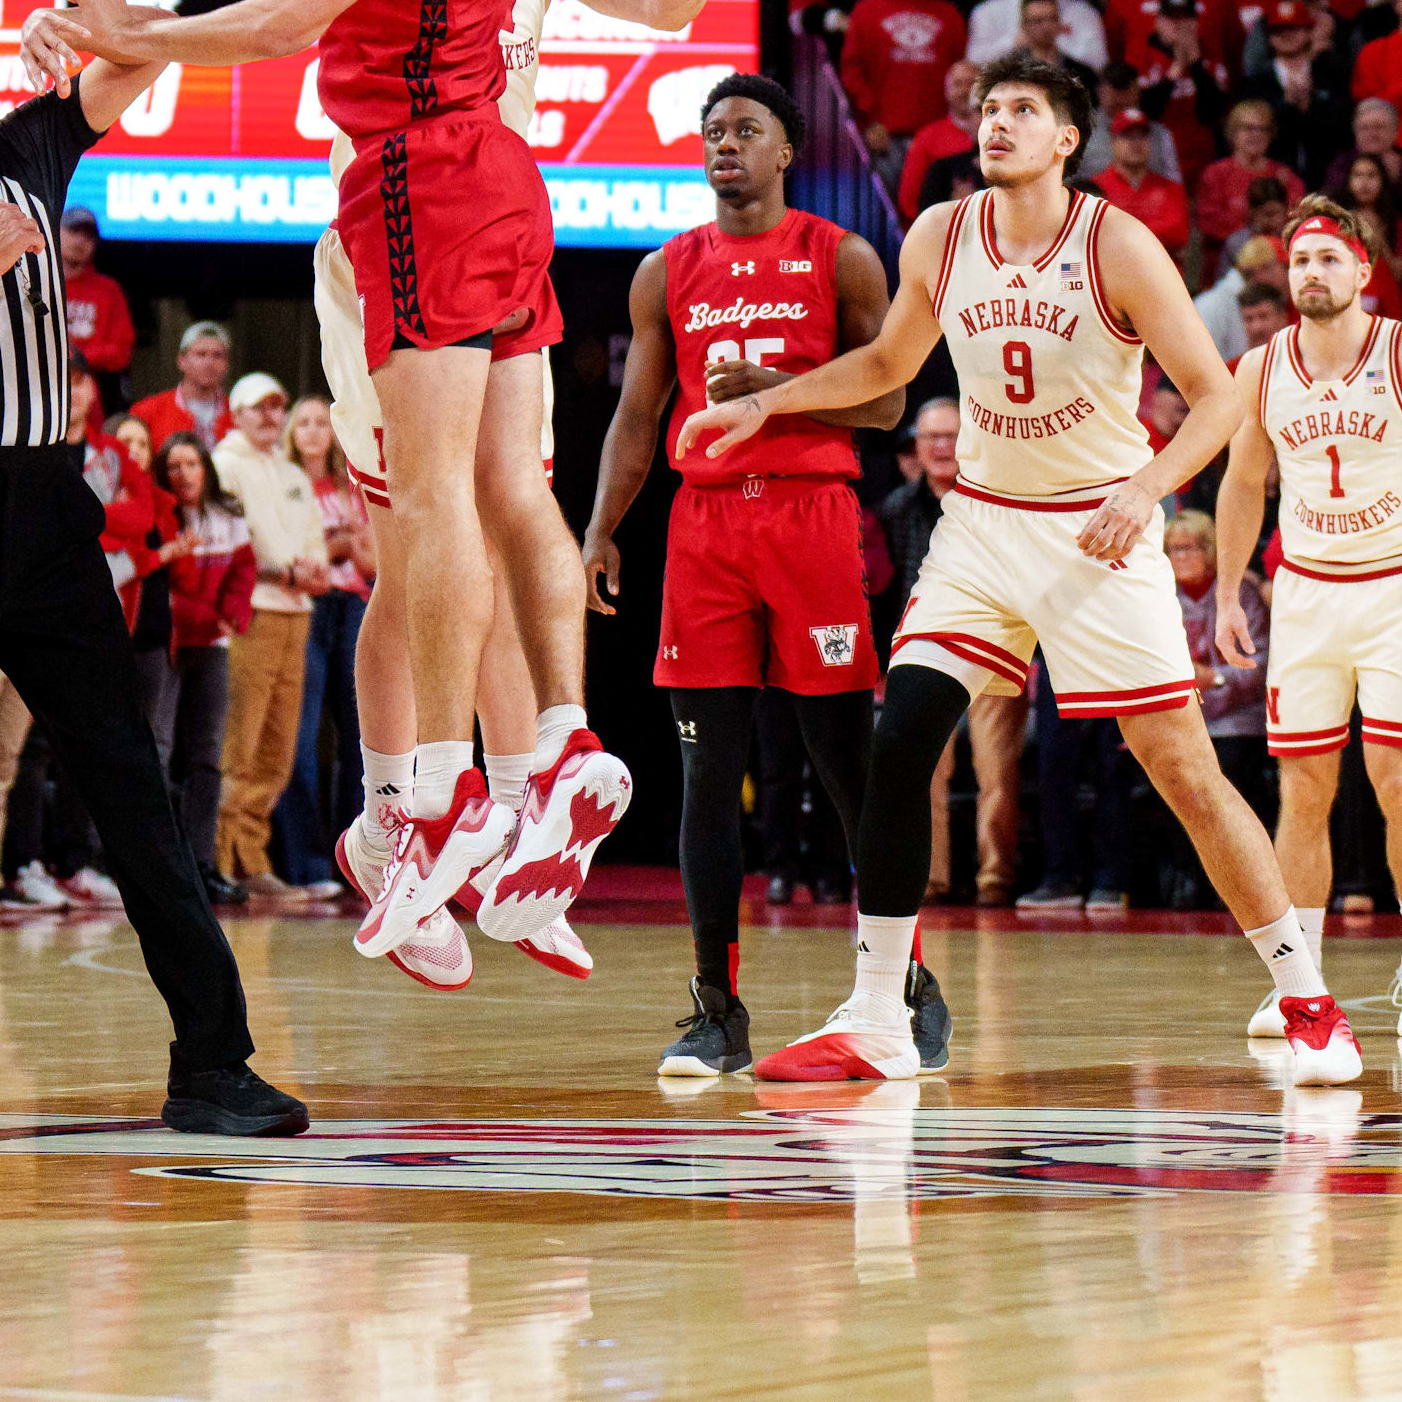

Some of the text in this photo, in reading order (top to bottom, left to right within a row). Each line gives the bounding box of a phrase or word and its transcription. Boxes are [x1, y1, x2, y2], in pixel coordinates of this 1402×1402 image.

[684, 297, 808, 333] Badgers
[959, 298, 1079, 341] NEBRASKA
[1002, 340, 1035, 404] 9
[968, 395, 1095, 440] CORNHUSKERS
[1279, 410, 1388, 451] NEBRASKA
[1326, 444, 1345, 498] 1
[1294, 490, 1401, 535] CORNHUSKERS
